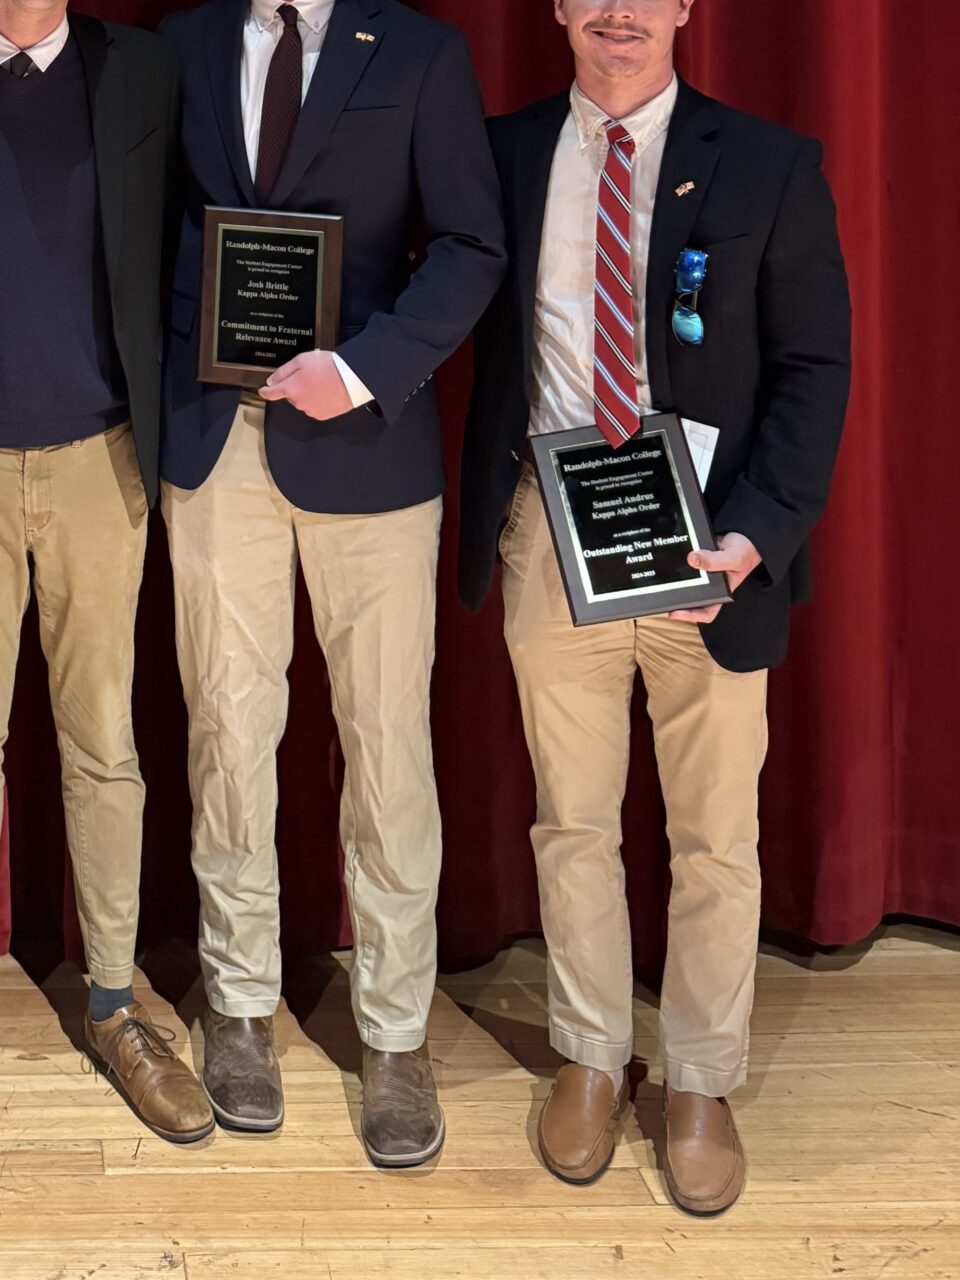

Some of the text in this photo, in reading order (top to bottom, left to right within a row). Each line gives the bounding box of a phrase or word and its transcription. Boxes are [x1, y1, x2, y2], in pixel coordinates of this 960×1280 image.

[226, 241, 315, 255] Randolph-Macon College
[248, 281, 289, 291] Josh Brittle
[279, 293, 299, 301] Order
[221, 320, 268, 331] Commitment
[278, 326, 313, 336] Fraternal
[235, 333, 272, 343] Relevance
[564, 449, 662, 472] Randolph-Macon College
[592, 493, 654, 509] Samuel Andrus
[592, 502, 661, 520] Kappa Alpha Order
[583, 534, 688, 558] Outstanding New Member
[626, 552, 653, 564] Award
